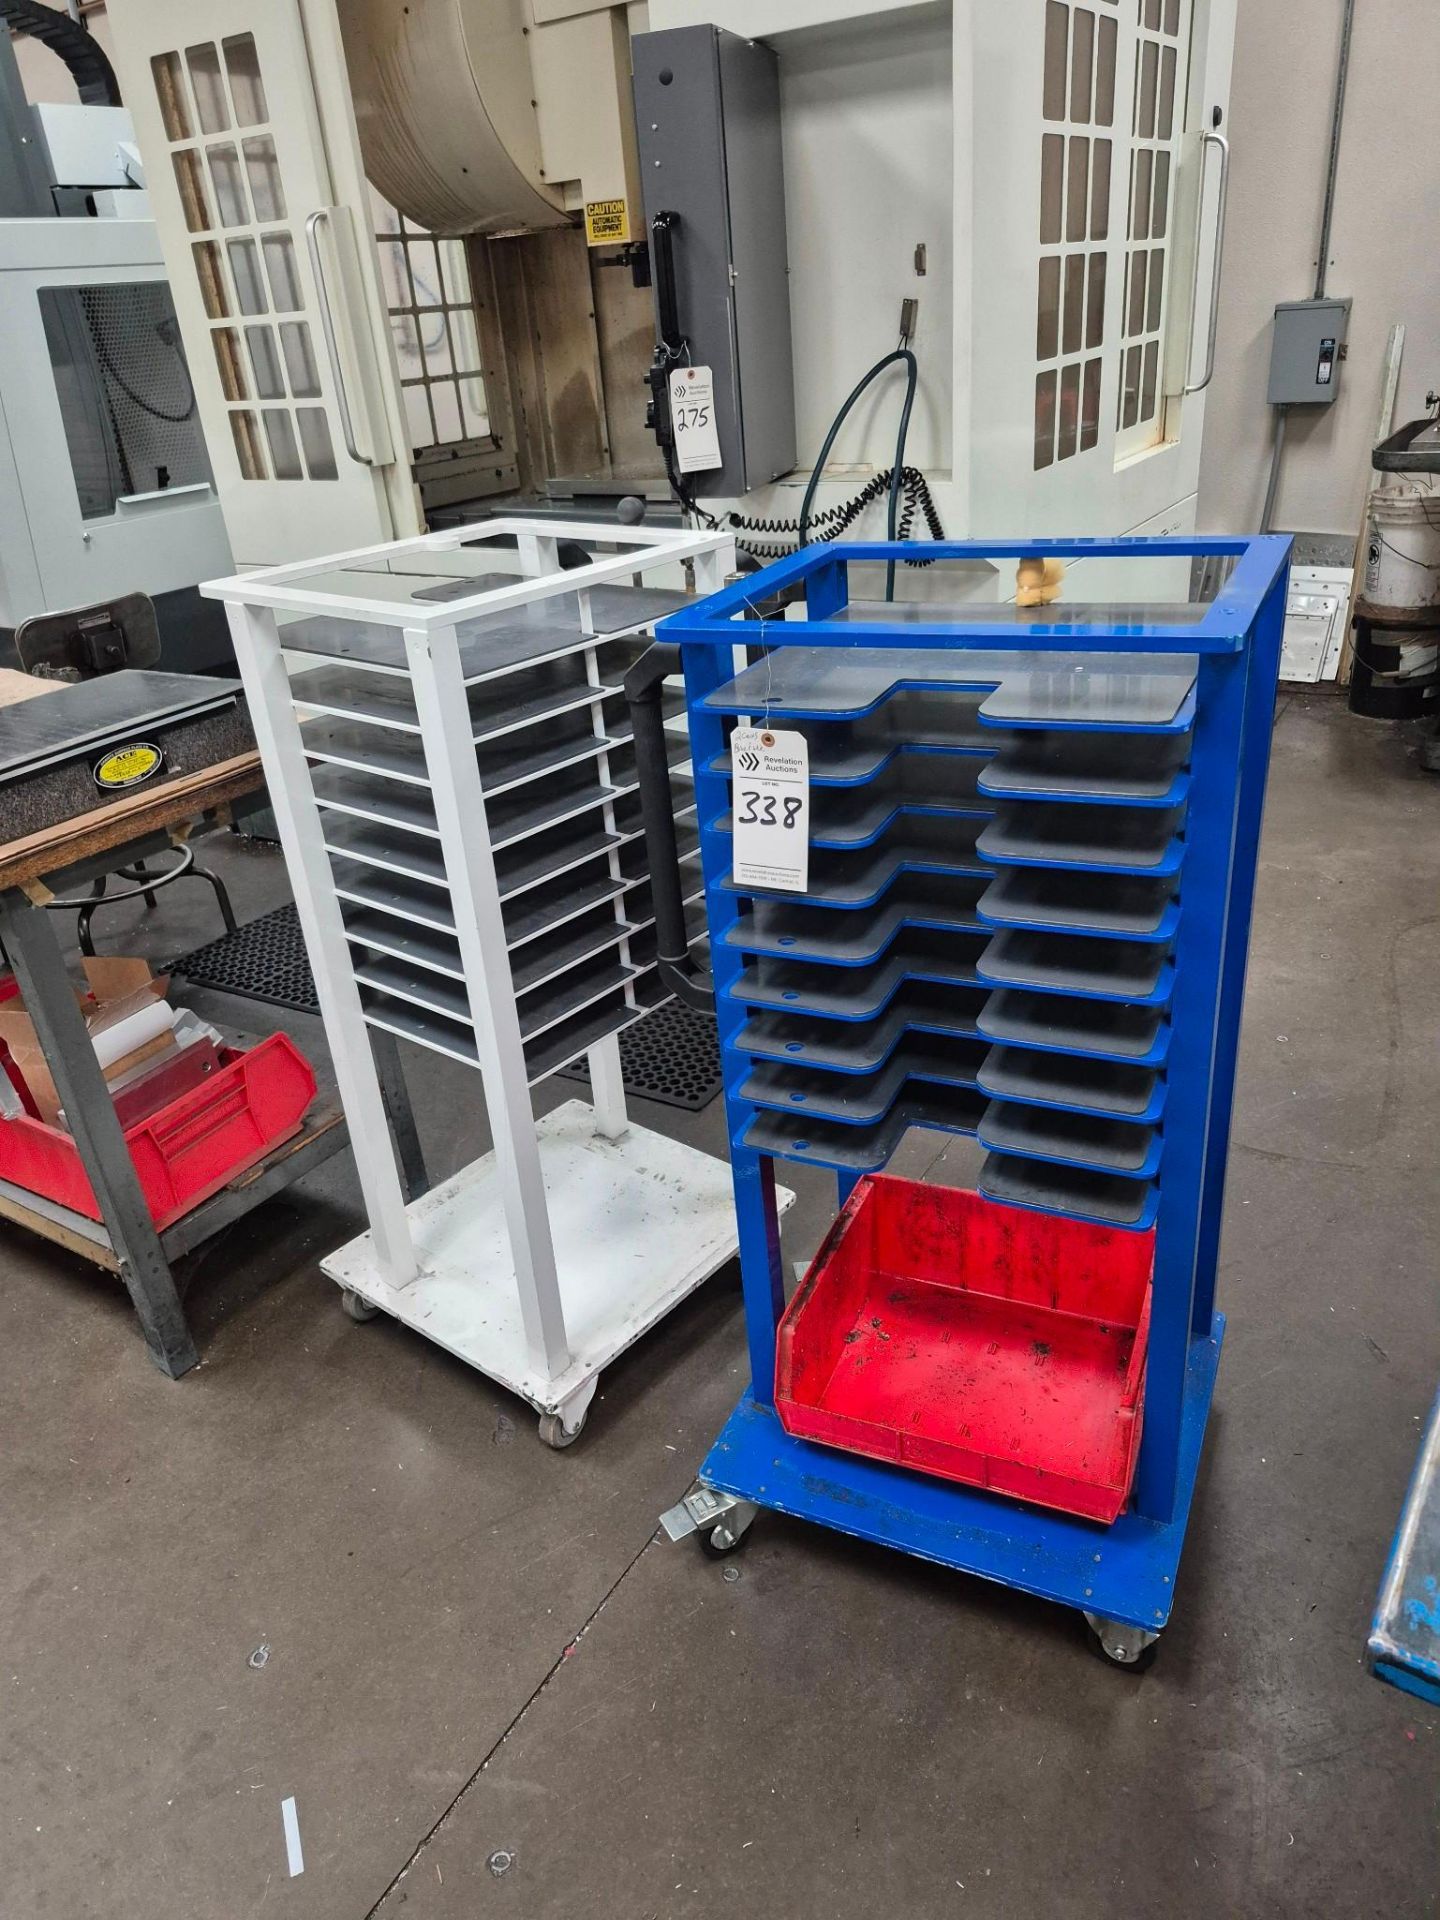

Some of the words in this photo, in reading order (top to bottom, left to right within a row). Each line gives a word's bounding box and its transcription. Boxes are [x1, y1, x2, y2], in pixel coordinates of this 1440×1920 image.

[588, 200, 625, 215] CAUTION
[677, 405, 711, 432] 275
[115, 751, 137, 763] ACE
[764, 755, 803, 766] Revelation
[765, 764, 798, 774] Auctions
[738, 791, 803, 829] 338
